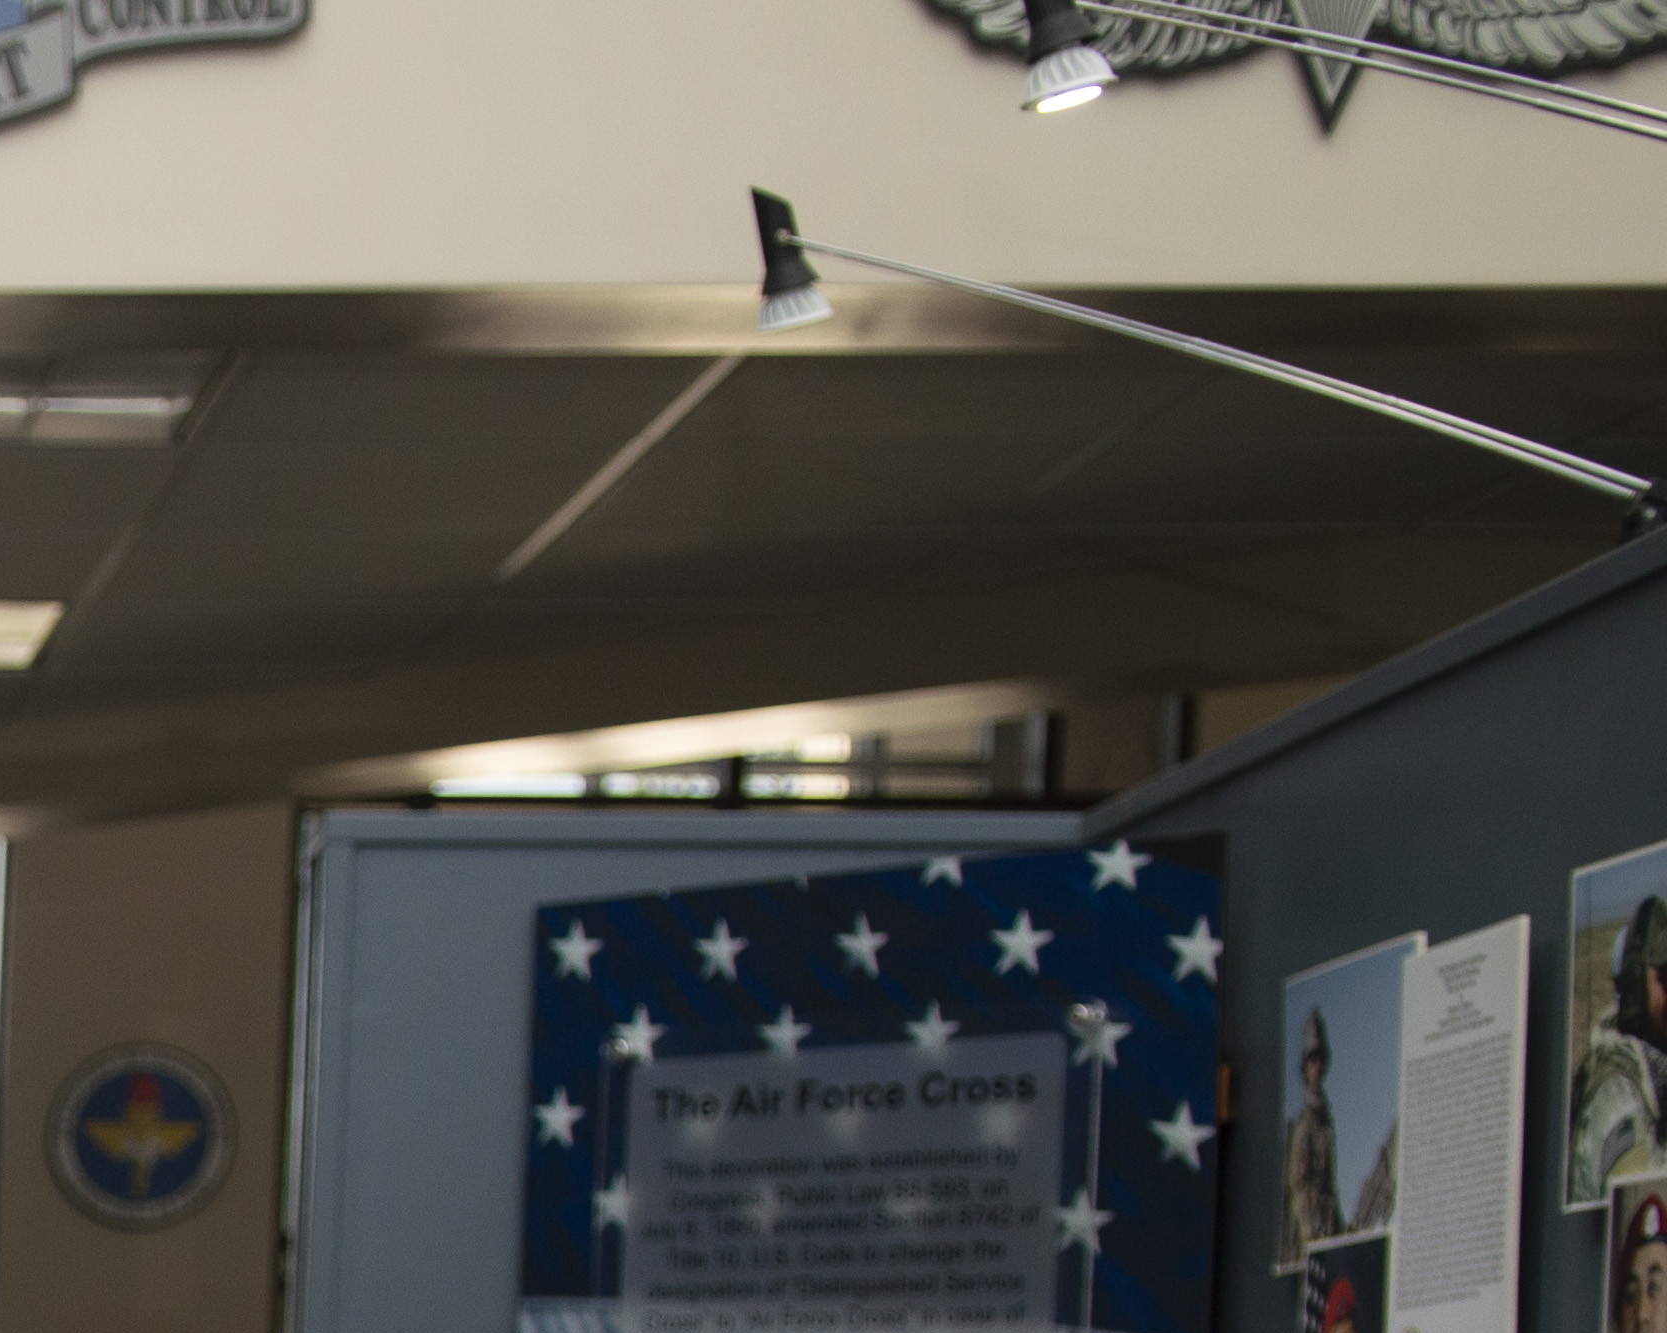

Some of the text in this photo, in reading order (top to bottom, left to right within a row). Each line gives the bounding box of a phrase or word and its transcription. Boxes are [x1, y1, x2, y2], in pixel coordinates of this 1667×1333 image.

[654, 1069, 1038, 1123] The Air Force Cross
